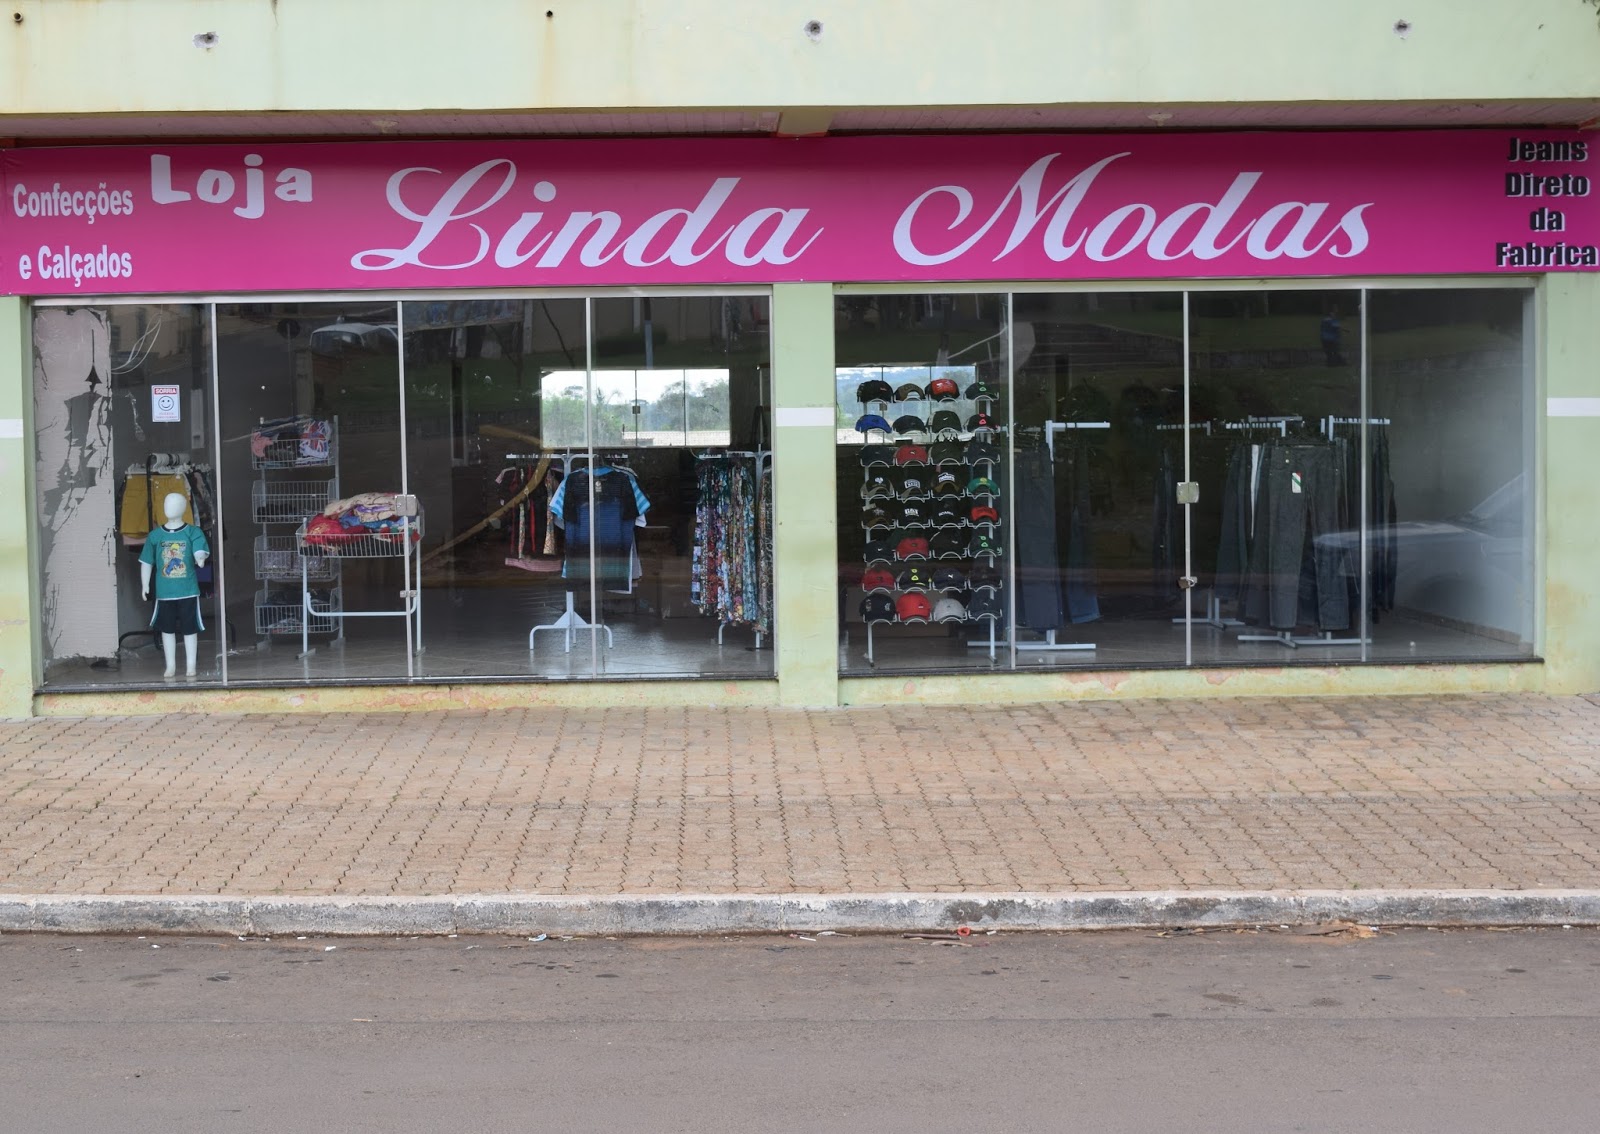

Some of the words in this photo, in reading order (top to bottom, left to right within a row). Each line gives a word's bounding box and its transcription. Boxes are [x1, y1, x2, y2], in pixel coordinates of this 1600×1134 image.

[1507, 137, 1588, 162] Jeans
[150, 153, 313, 219] Loja
[1505, 172, 1591, 197] Direto
[13, 182, 134, 224] Confecções
[350, 158, 825, 271] Linda
[893, 151, 1375, 266] Modas
[1529, 207, 1566, 232] da
[19, 254, 32, 280] e
[38, 244, 133, 288] Calçados
[1496, 242, 1600, 267] Fabrica
